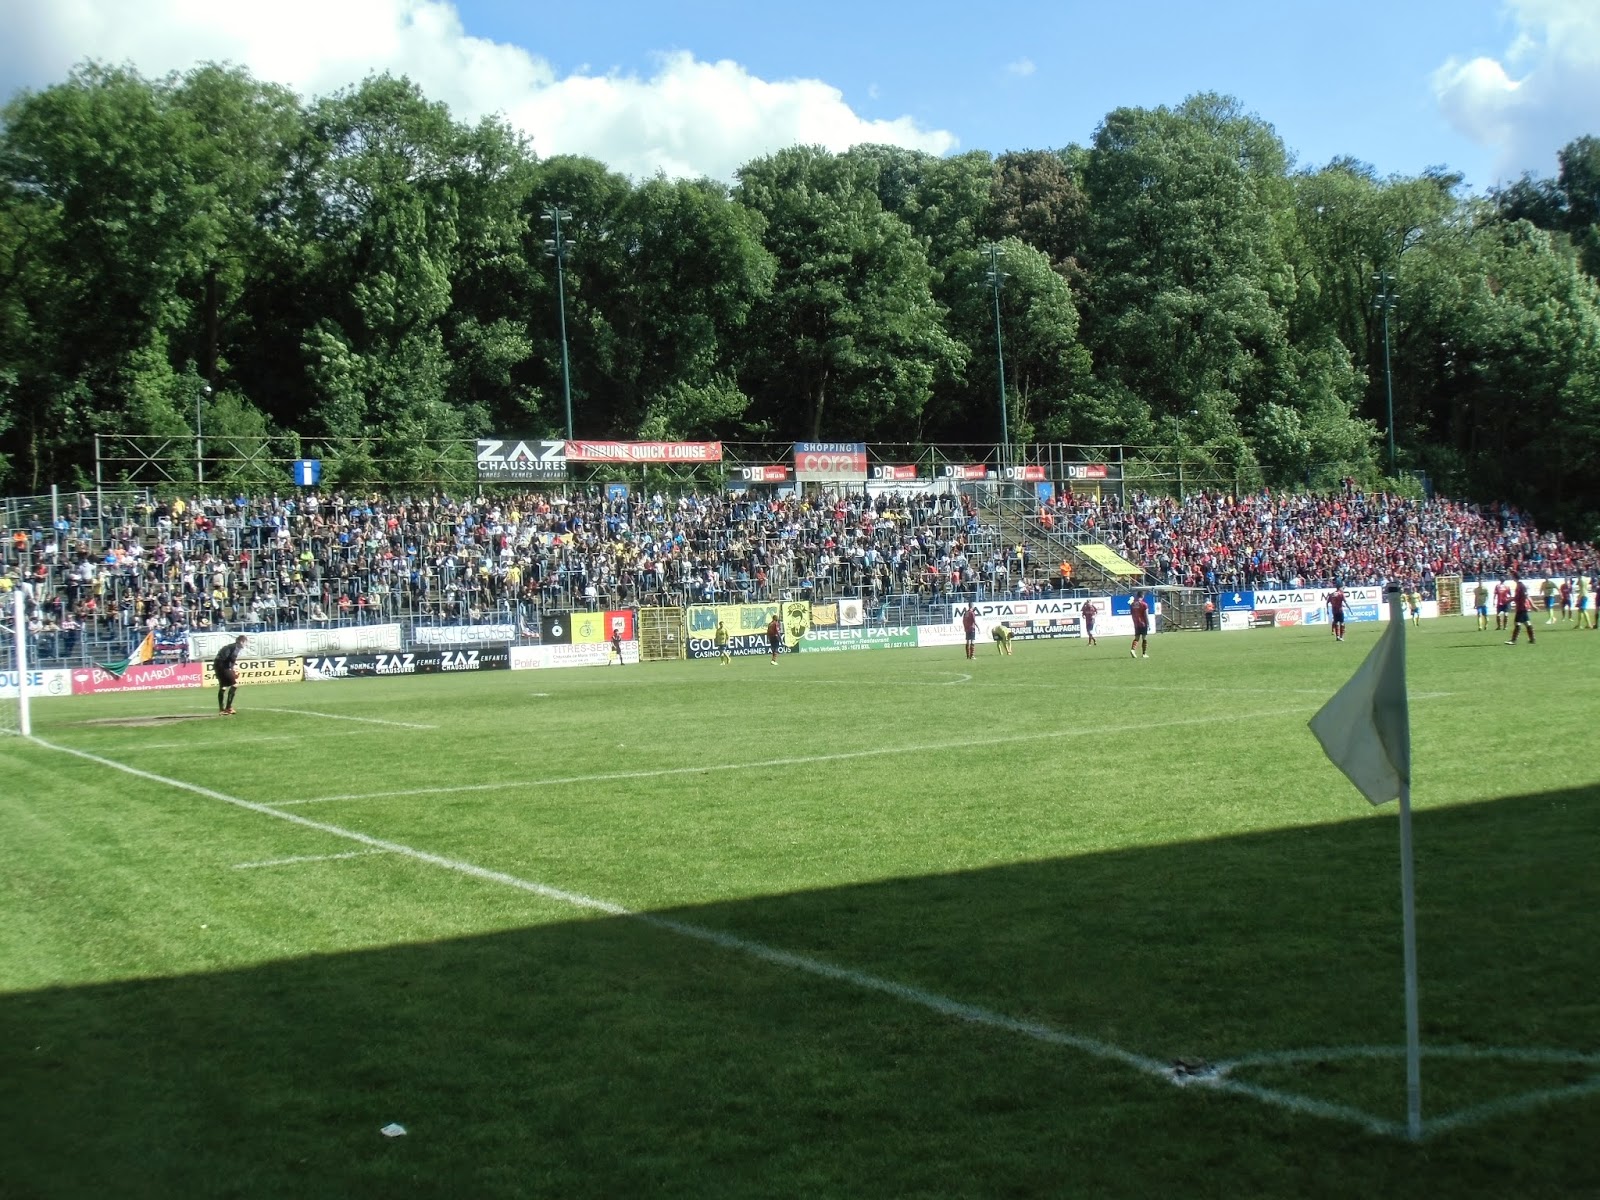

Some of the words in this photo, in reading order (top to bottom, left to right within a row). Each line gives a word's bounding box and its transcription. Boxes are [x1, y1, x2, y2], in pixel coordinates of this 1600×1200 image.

[477, 440, 566, 461] ZAZ
[581, 445, 629, 457] TRIBUNE
[632, 446, 665, 458] QUICK
[669, 446, 705, 457] LOUISE
[803, 443, 852, 452] SHOPPING
[477, 461, 567, 470] CHAUSSURES
[804, 455, 852, 472] cora
[1256, 594, 1303, 604] MAPTA
[1320, 591, 1365, 601] MPTA
[1035, 602, 1083, 613] MAPT
[804, 630, 863, 641] GREEN
[867, 626, 911, 637] PARK
[1045, 624, 1080, 632] CAMPAGNE
[552, 641, 638, 654] TITRES-SERVCES
[689, 635, 745, 652] GOLEN
[441, 650, 480, 666] ZAZ
[694, 651, 720, 659] CASINO
[733, 648, 766, 656] MACHINES
[306, 656, 348, 673] ZAZ
[375, 653, 415, 669] ZAZ
[416, 658, 440, 666] FEMMES
[441, 663, 480, 671] CHAUSSURES
[135, 664, 179, 685] MAROT
